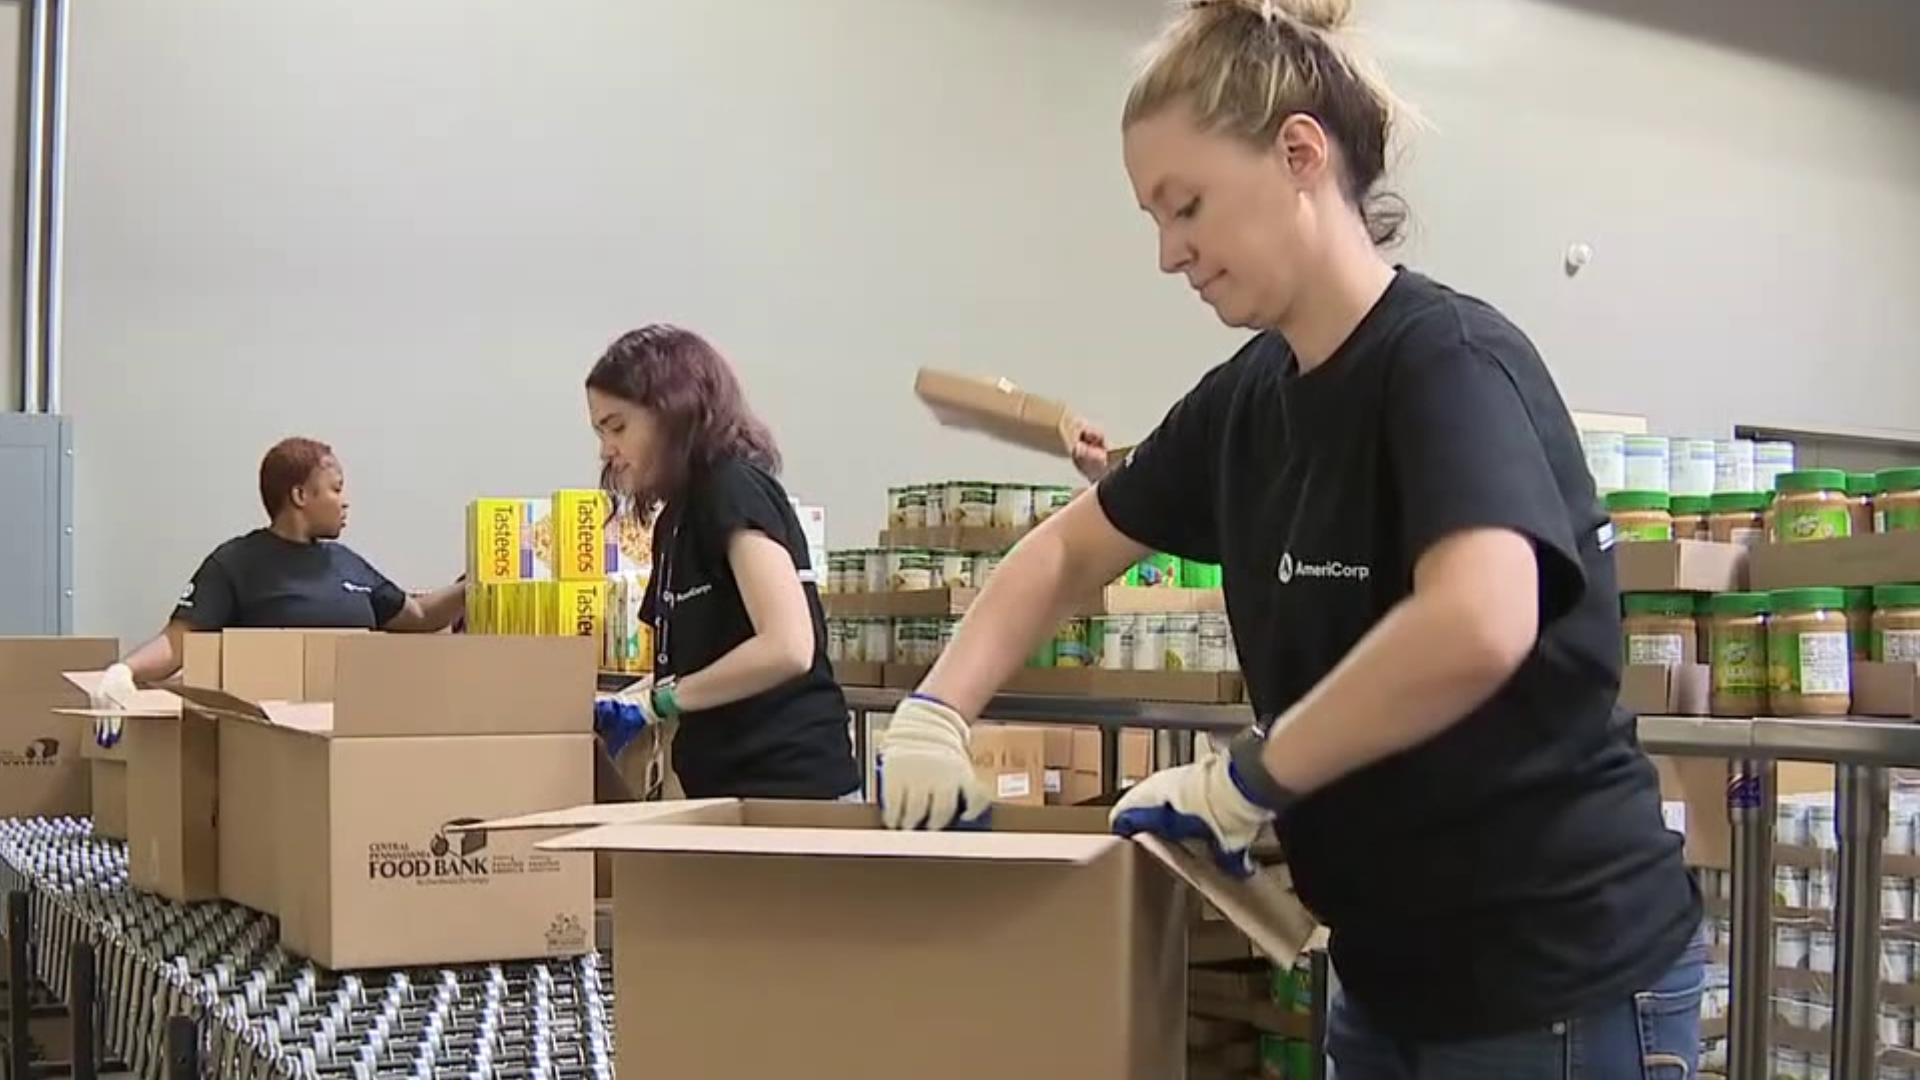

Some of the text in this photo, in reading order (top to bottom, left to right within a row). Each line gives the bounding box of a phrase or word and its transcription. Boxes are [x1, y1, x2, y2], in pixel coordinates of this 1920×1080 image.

[576, 498, 596, 572] Tasteeos
[369, 843, 410, 852] CENTRAL
[369, 860, 431, 879] FOOD
[435, 857, 488, 876] BANK
